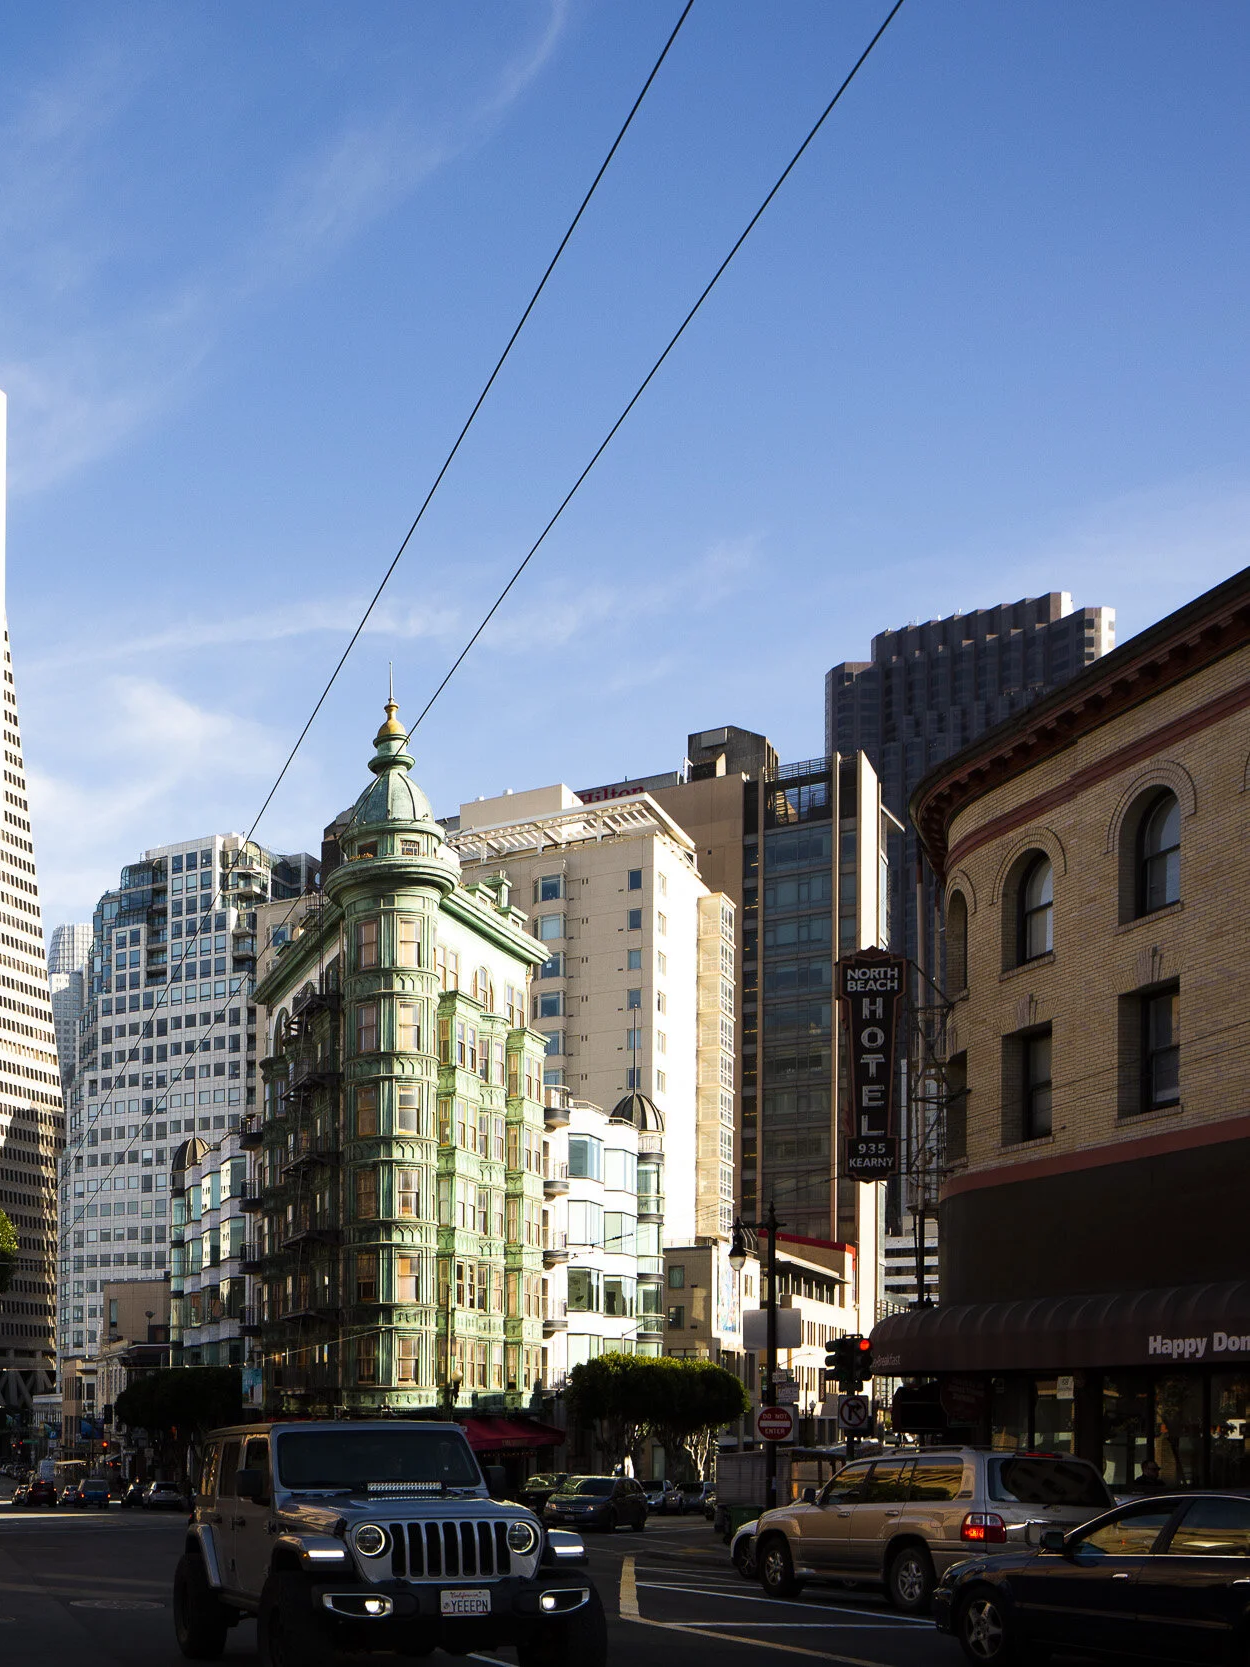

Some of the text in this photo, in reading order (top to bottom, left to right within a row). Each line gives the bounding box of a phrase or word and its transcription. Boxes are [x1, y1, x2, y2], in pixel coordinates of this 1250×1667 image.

[579, 786, 644, 802] Hilton
[847, 968, 898, 980] NORTH
[847, 980, 898, 992] BEACH
[860, 997, 885, 1137] HOTEL
[858, 1143, 886, 1154] 935
[849, 1157, 894, 1167] KEARNY
[1148, 1332, 1250, 1359] Happy Don
[451, 1600, 488, 1612] YEEEPN
